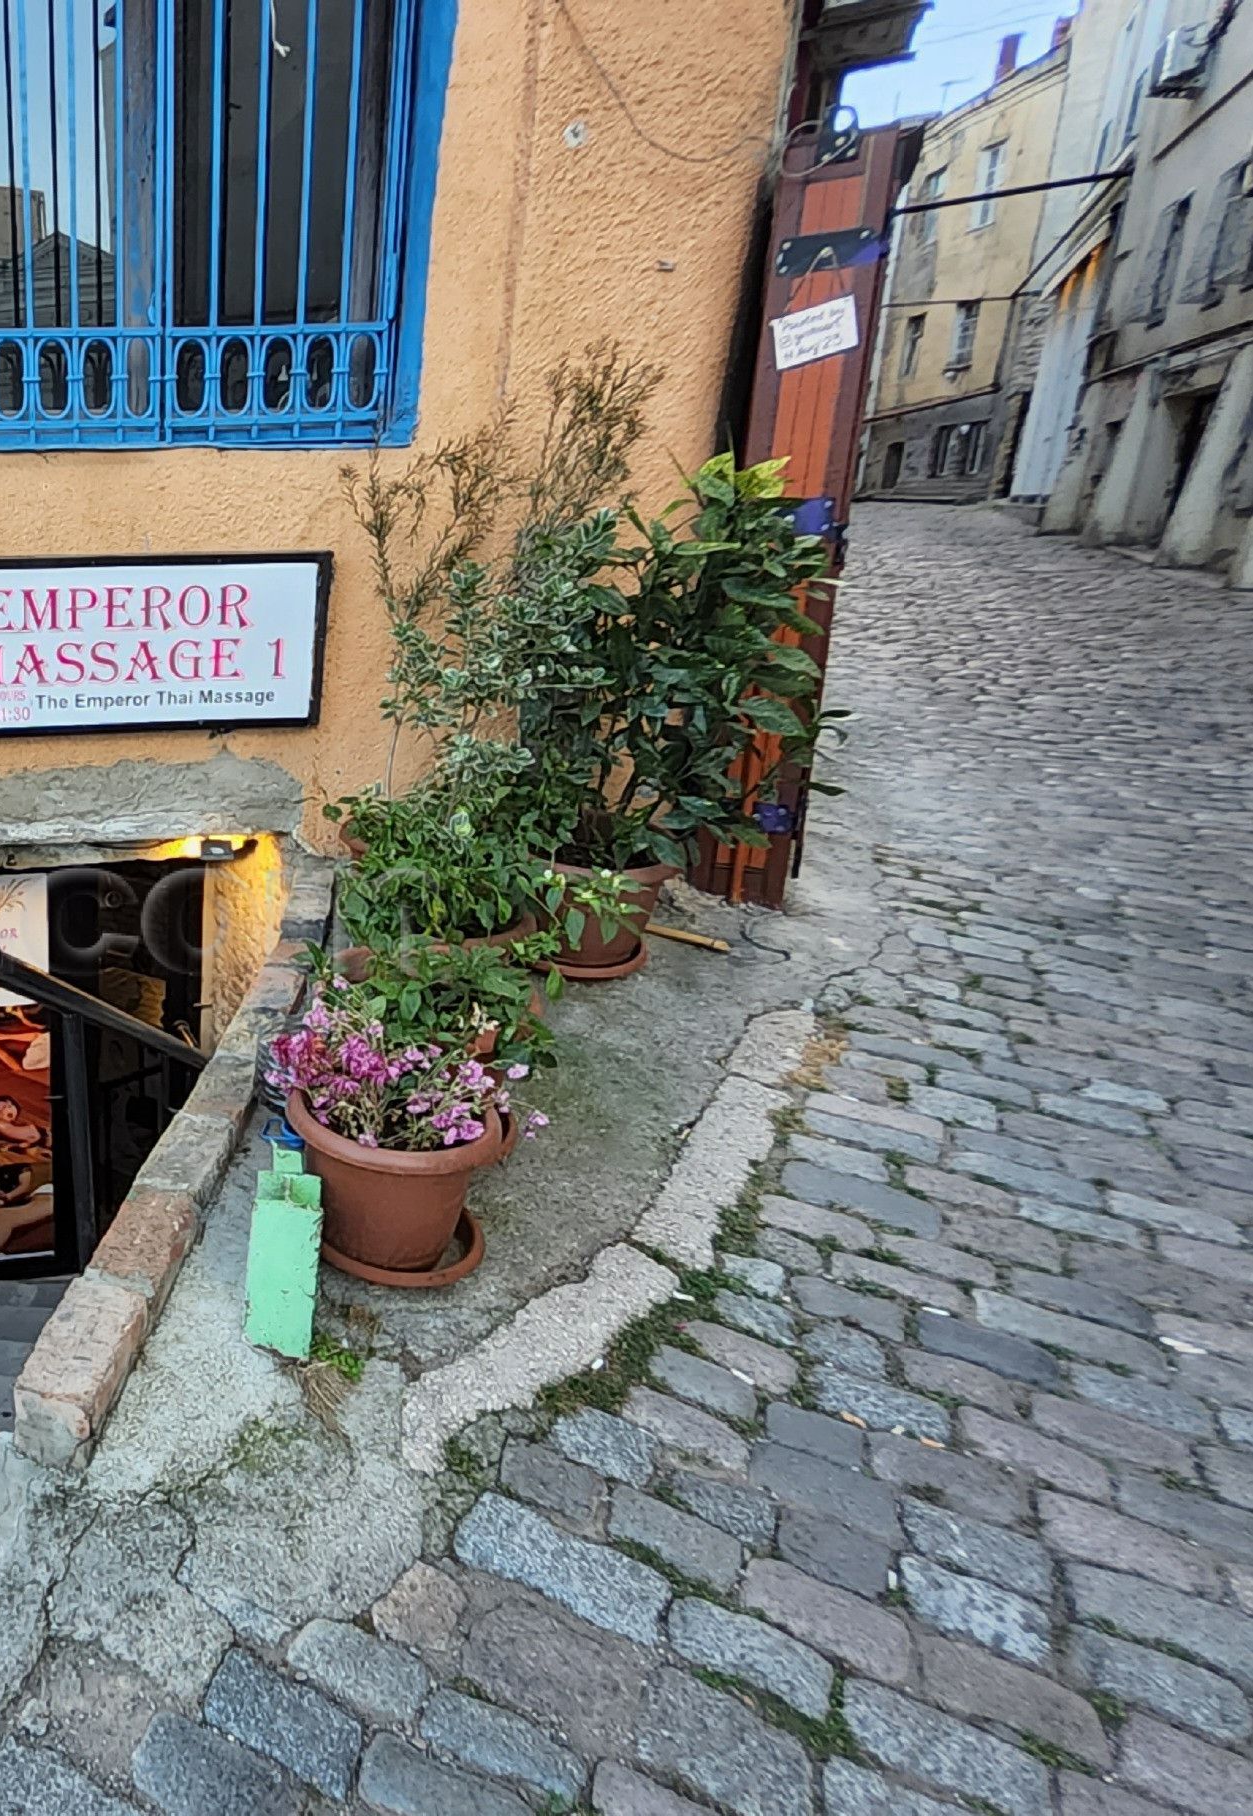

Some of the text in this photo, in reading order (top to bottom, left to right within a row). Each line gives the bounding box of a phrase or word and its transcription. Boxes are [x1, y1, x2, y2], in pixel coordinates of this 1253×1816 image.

[267, 637, 287, 681] 1
[35, 689, 276, 711] The Emperor Thai Massage
